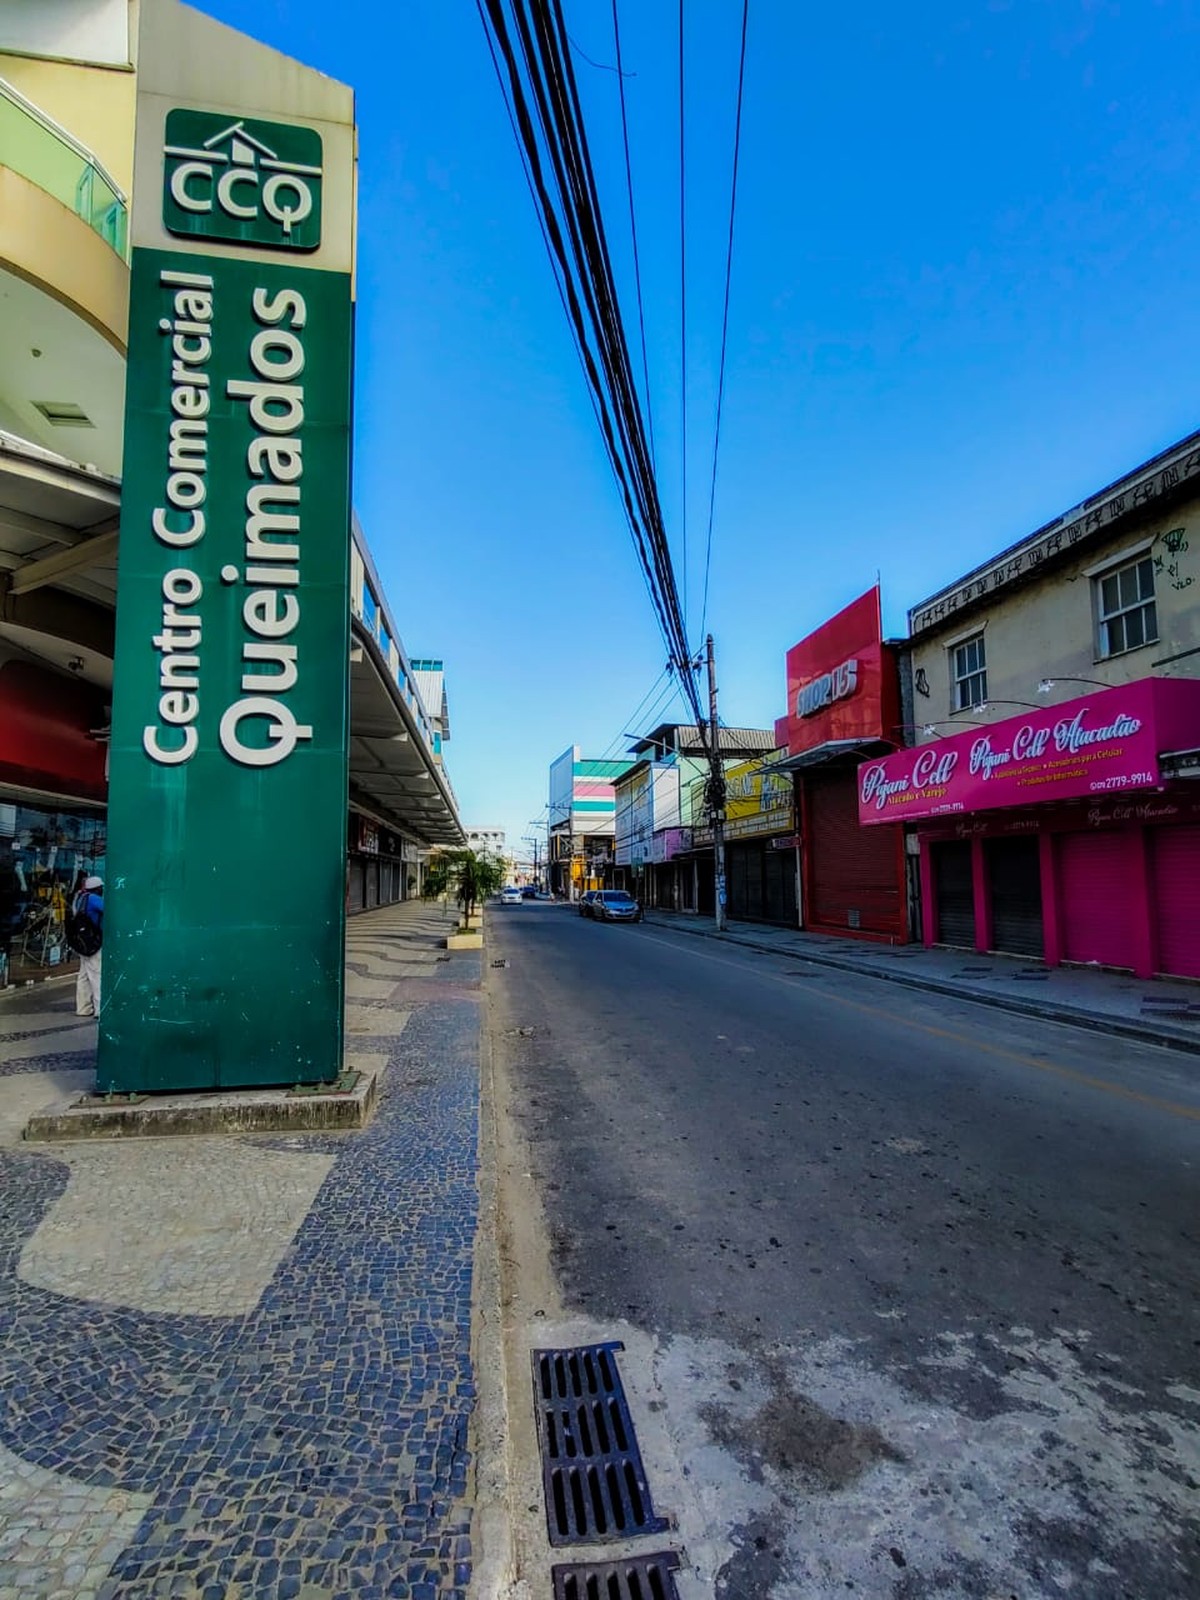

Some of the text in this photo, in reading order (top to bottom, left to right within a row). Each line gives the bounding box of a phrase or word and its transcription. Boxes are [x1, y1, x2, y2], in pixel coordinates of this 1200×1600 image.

[170, 161, 313, 234] CCQ
[143, 270, 214, 765] Centro Comercial
[218, 287, 313, 768] Queimados
[796, 659, 858, 719] SHOP 15
